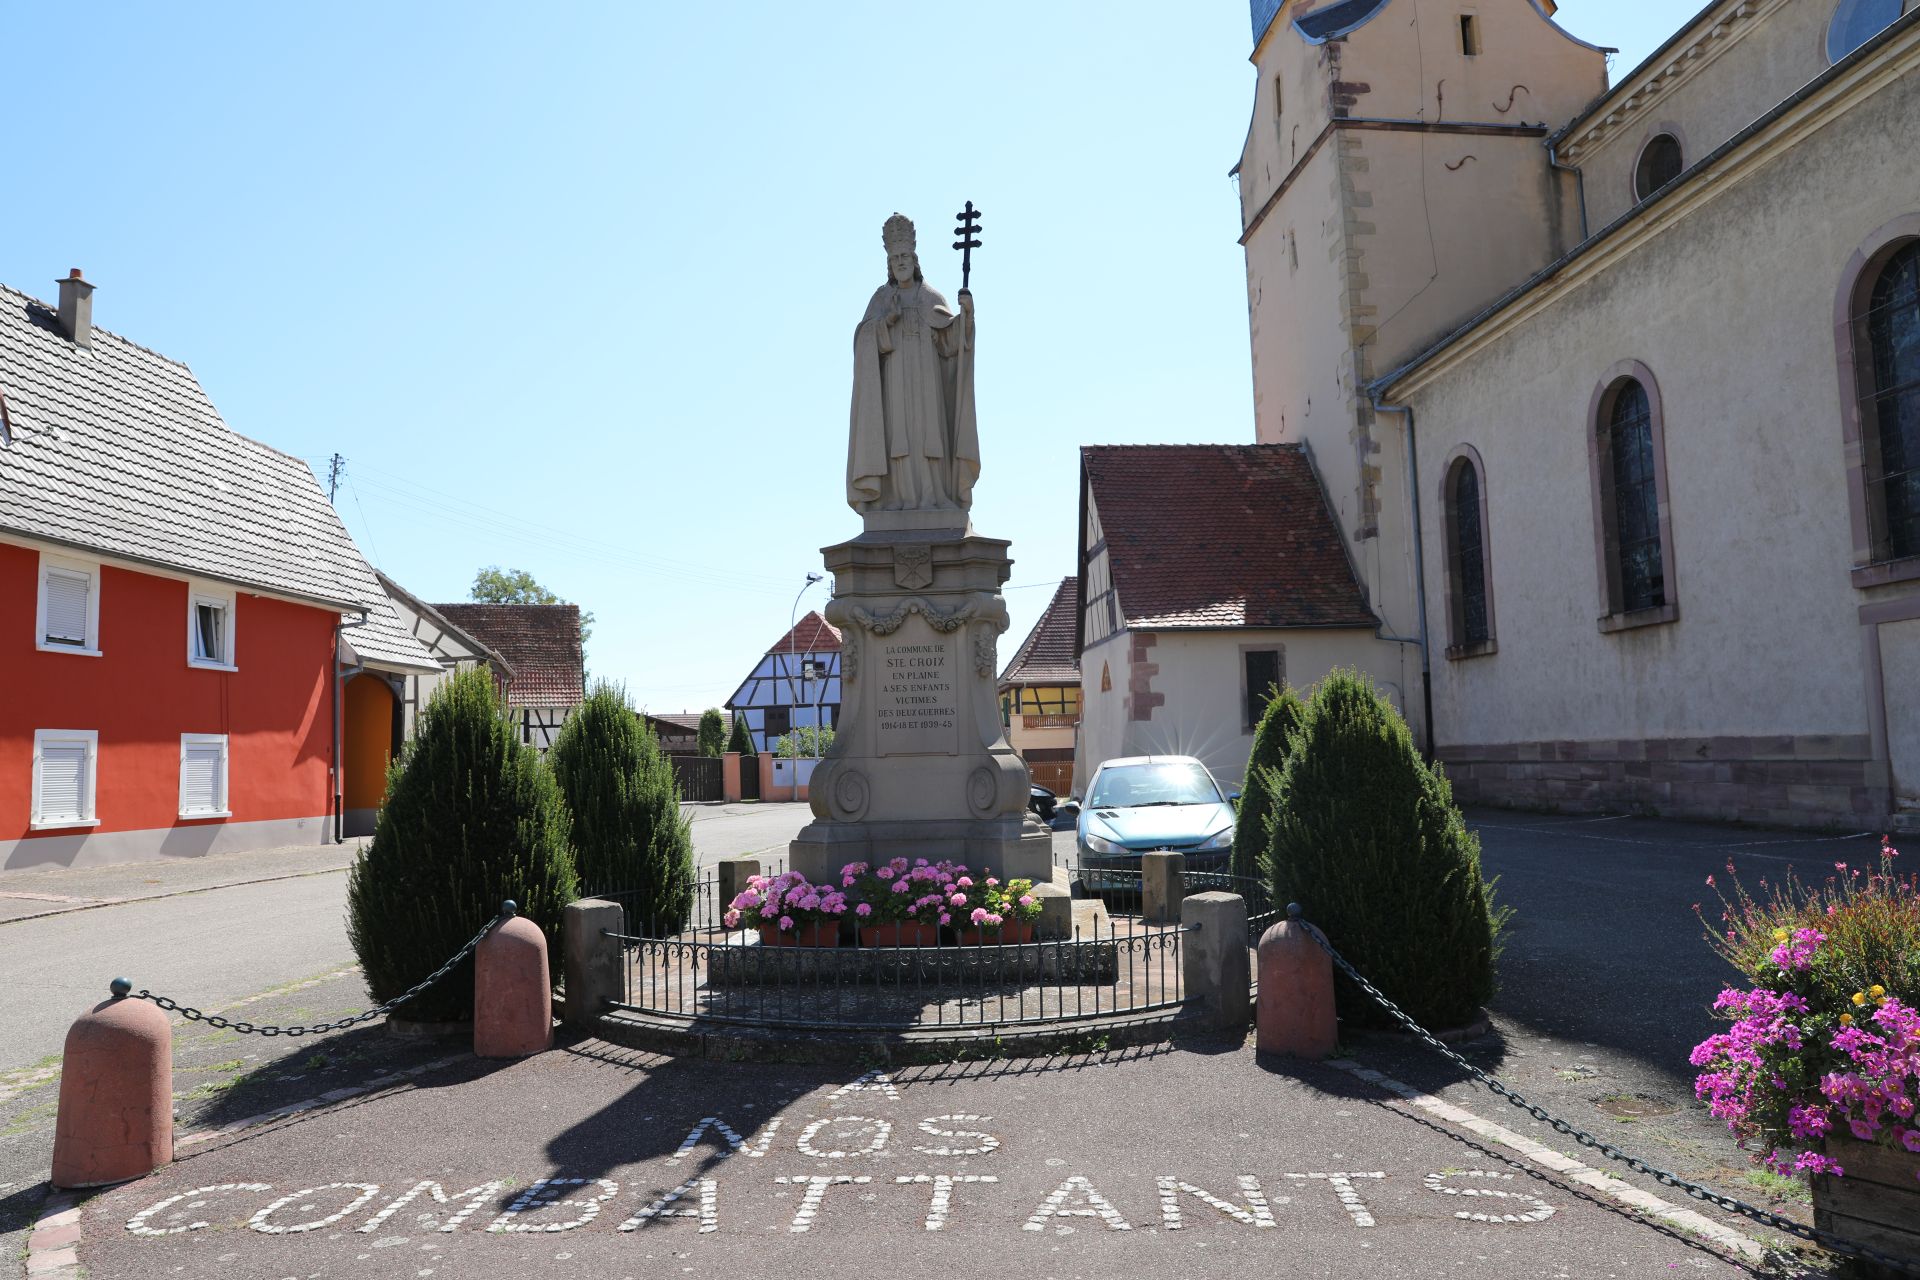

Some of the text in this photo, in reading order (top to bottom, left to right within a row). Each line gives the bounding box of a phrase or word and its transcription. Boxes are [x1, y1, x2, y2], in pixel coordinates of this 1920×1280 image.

[886, 645, 945, 655] LA COMMUNE DE
[887, 657, 945, 668] STE CROIX
[892, 671, 940, 680] EN PLAINE
[883, 683, 950, 692] A SES ENFANTS
[895, 696, 937, 704] VICTIMES
[878, 707, 956, 717] DES DEUX GUERRES
[881, 720, 953, 730] 1914-18 ET 1939-45
[824, 1068, 901, 1101] A
[665, 1114, 1003, 1166] NOS
[124, 1169, 1559, 1237] COMBATTANTS
